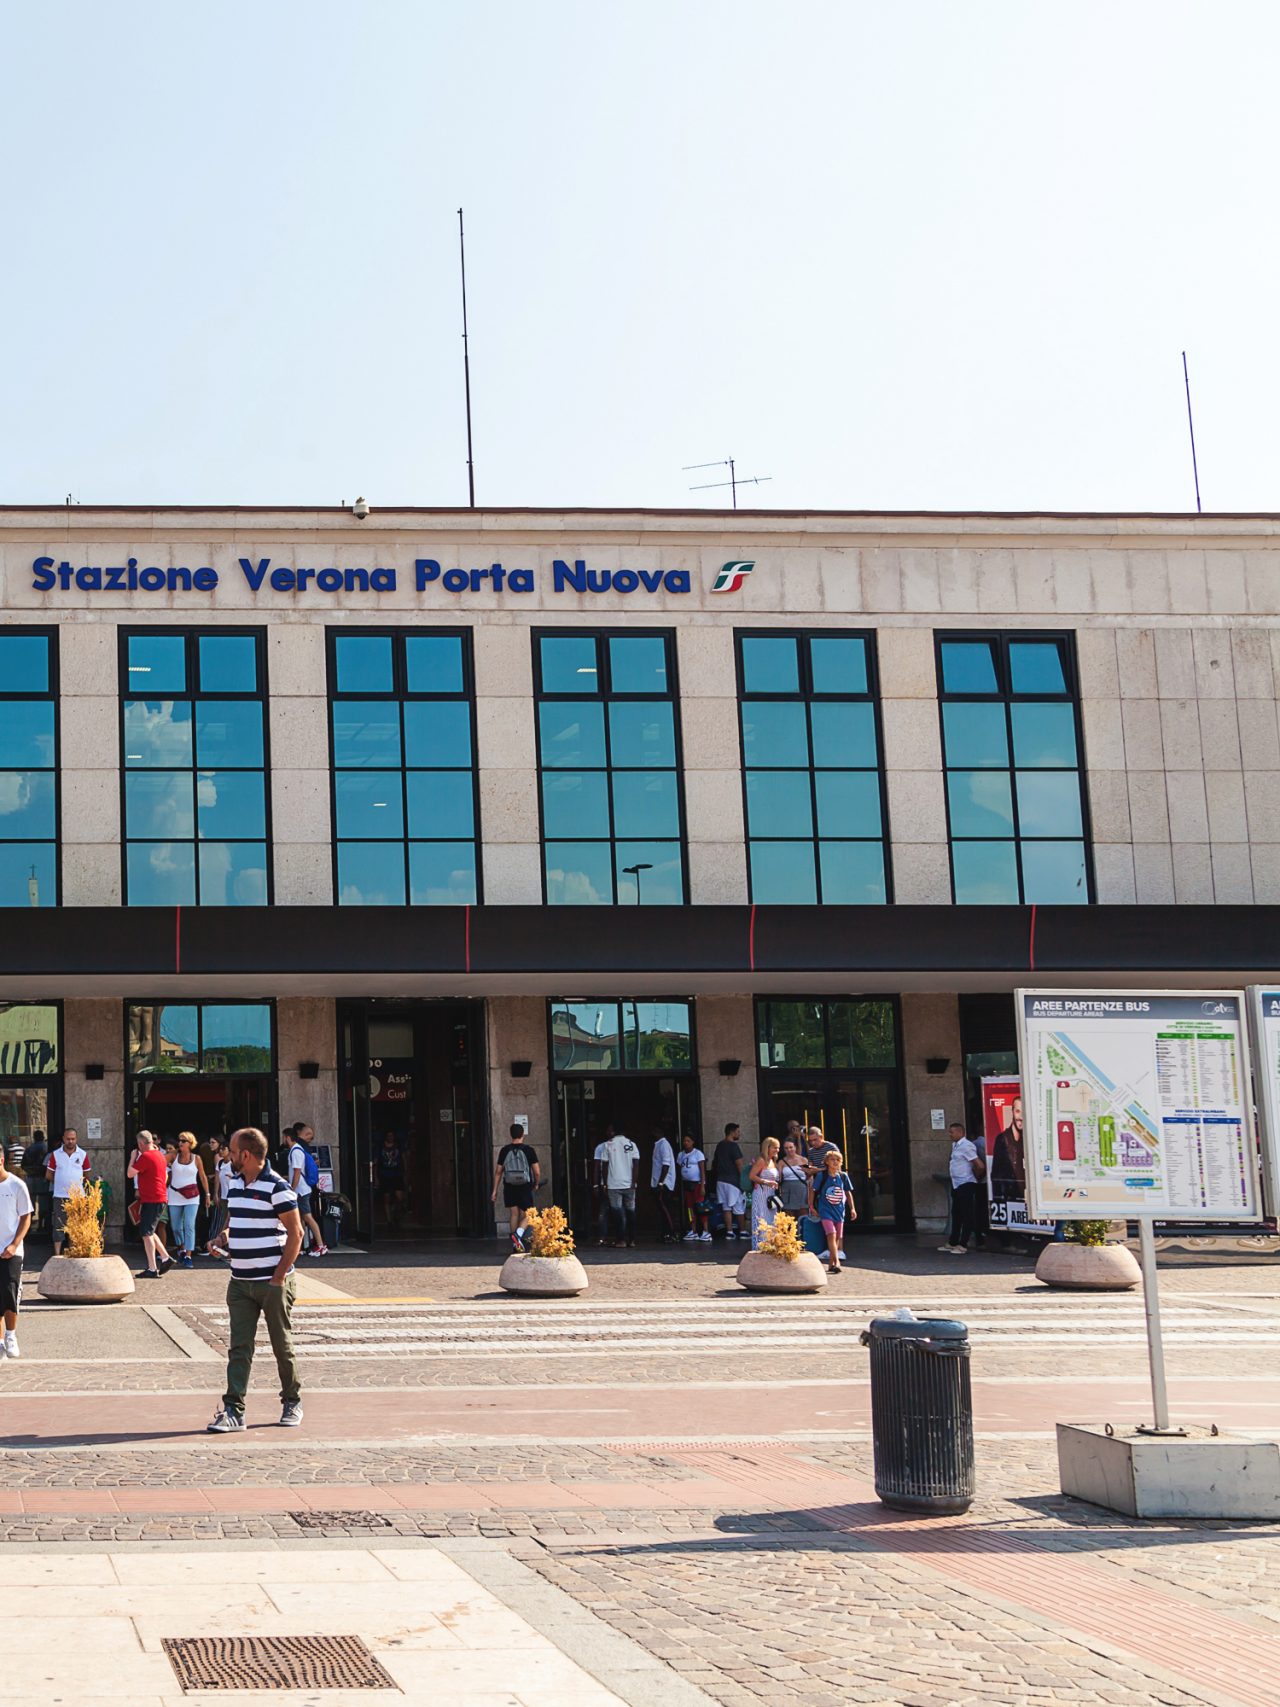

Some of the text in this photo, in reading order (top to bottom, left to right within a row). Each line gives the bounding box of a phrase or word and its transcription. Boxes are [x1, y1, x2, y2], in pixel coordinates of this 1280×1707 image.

[32, 557, 692, 593] Stazione Verona Porta Nuova
[1033, 1001, 1150, 1011] AREE PARTENZE BUS
[1062, 1125, 1070, 1133] A
[991, 1202, 1007, 1222] 25
